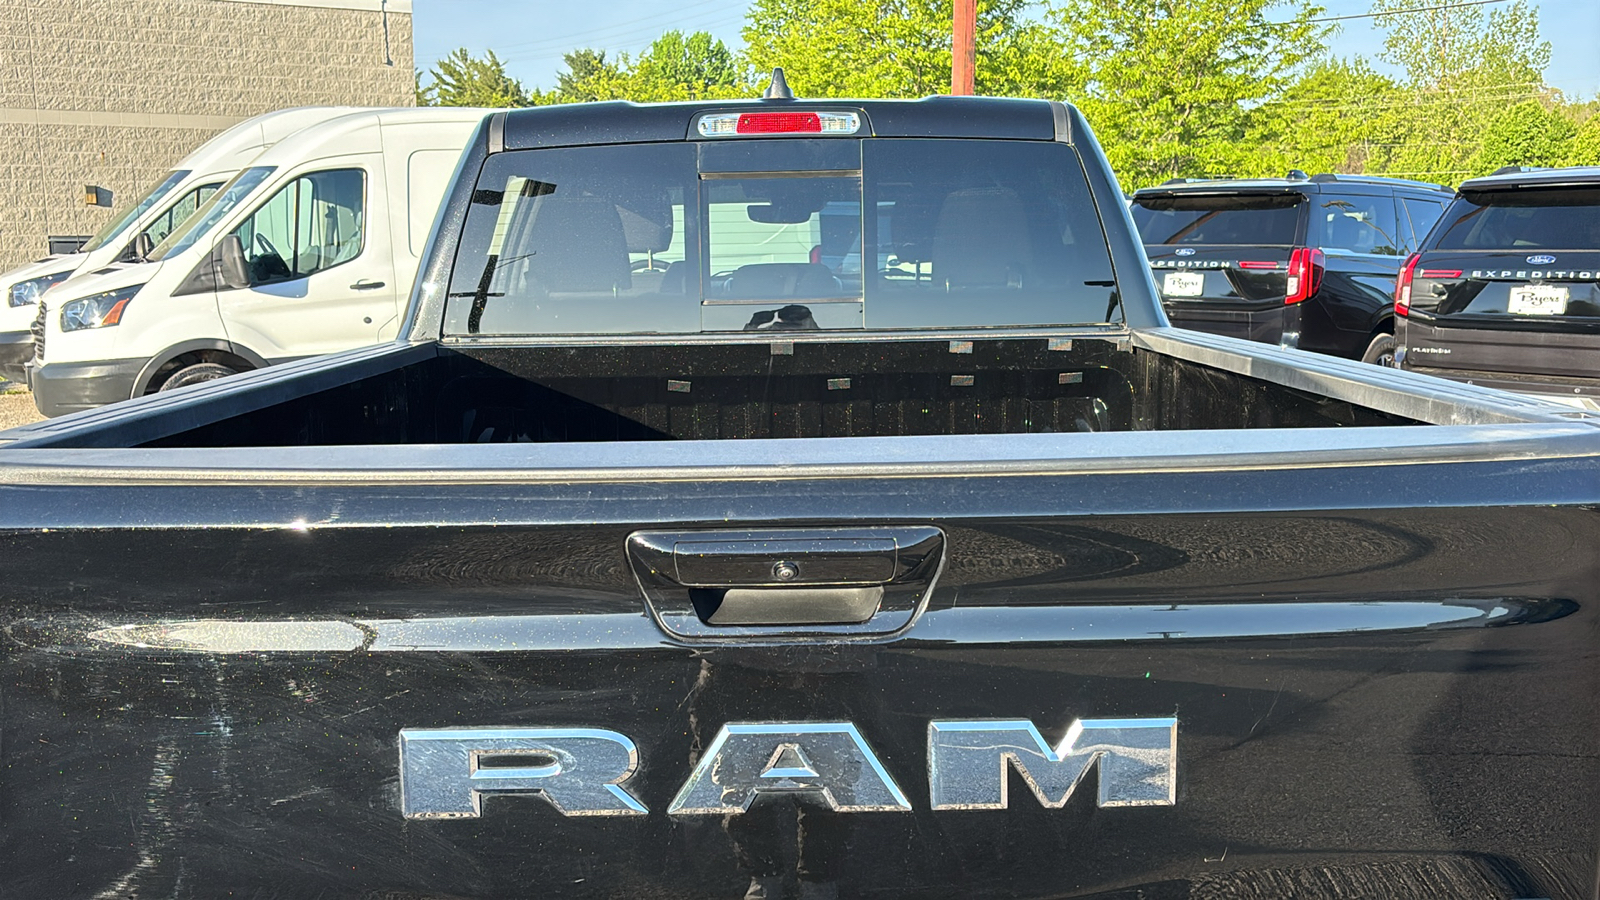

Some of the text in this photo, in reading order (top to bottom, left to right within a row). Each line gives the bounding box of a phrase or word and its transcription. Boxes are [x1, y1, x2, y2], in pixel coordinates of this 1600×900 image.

[1148, 260, 1231, 268] XPEDITION
[1516, 291, 1560, 306] Byers
[399, 717, 1178, 819] RAM
